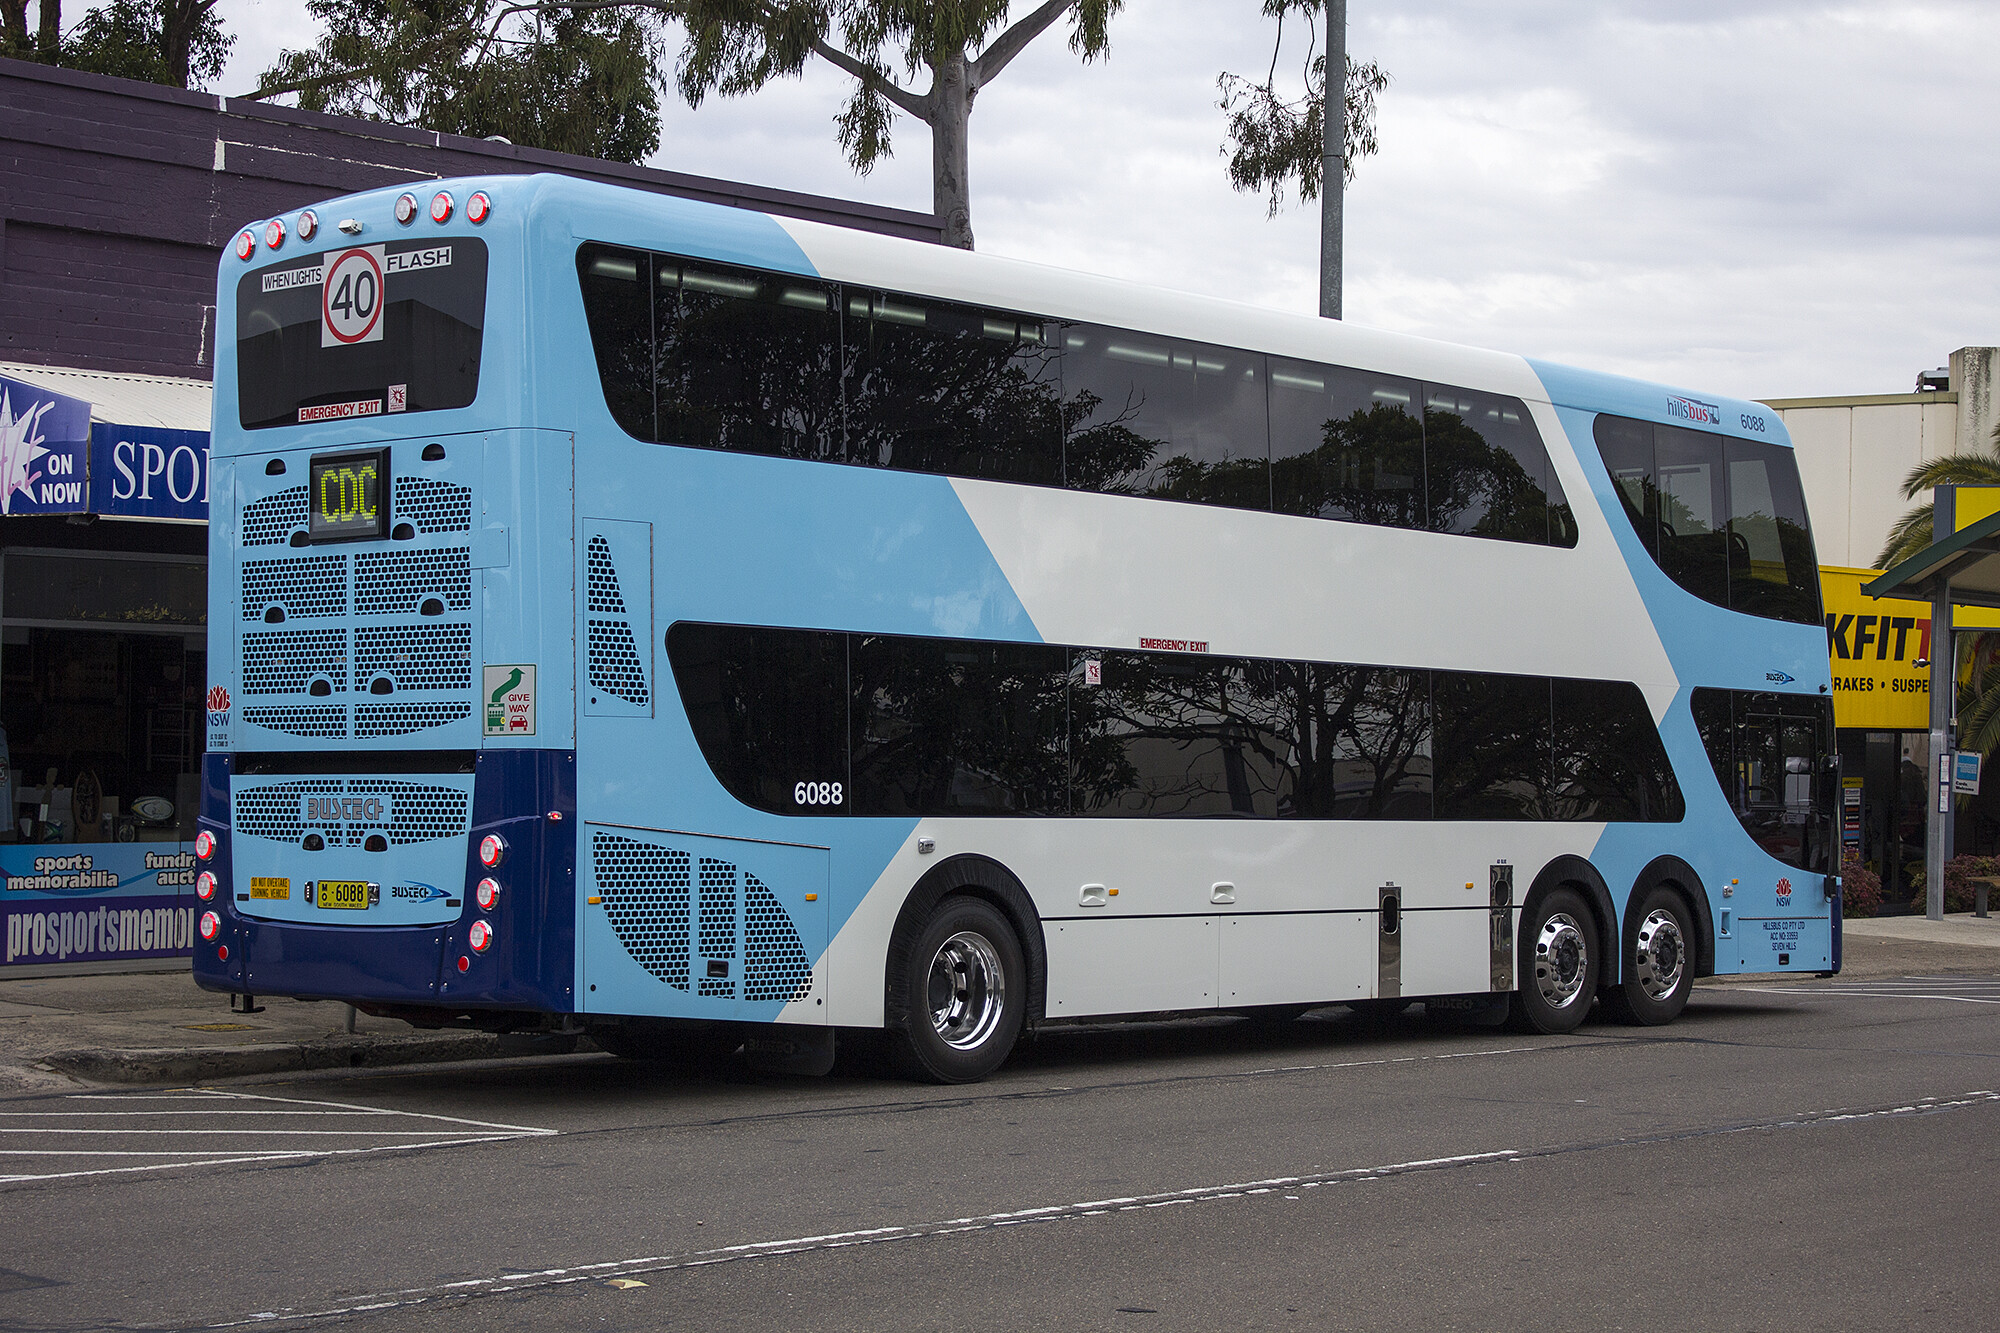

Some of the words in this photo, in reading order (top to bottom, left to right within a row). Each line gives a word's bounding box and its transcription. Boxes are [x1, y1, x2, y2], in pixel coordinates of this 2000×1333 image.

[387, 248, 450, 271] FLASH
[263, 272, 290, 290] WHEN
[291, 268, 322, 286] LIGHTS
[331, 270, 376, 320] 40
[300, 403, 355, 421] EMERGENCY
[358, 400, 380, 414] EXIT
[1666, 397, 1709, 422] hillsbus
[1740, 413, 1766, 433] 6088
[48, 454, 73, 475] ON
[41, 482, 82, 504] NOW
[320, 465, 377, 523] CDC
[1140, 638, 1188, 651] EMERGENCY
[1190, 641, 1208, 653] EXIT
[1831, 677, 1874, 692] RAKES
[1892, 678, 1930, 693] SUSPE
[508, 693, 530, 702] GIVE
[508, 704, 530, 713] WAY
[207, 713, 231, 727] NSW
[794, 781, 844, 805] 6088
[307, 797, 385, 821] BUSTECH
[35, 853, 93, 875] sports
[7, 871, 119, 890] memorabilia
[336, 883, 364, 902] 6088
[391, 886, 429, 899] BUSTECH
[1776, 897, 1791, 907] NSW
[1763, 921, 1781, 930] HILLSBUS
[1789, 921, 1797, 930] PTY
[1772, 942, 1785, 951] SEVEN
[1786, 942, 1796, 950] HILLS
